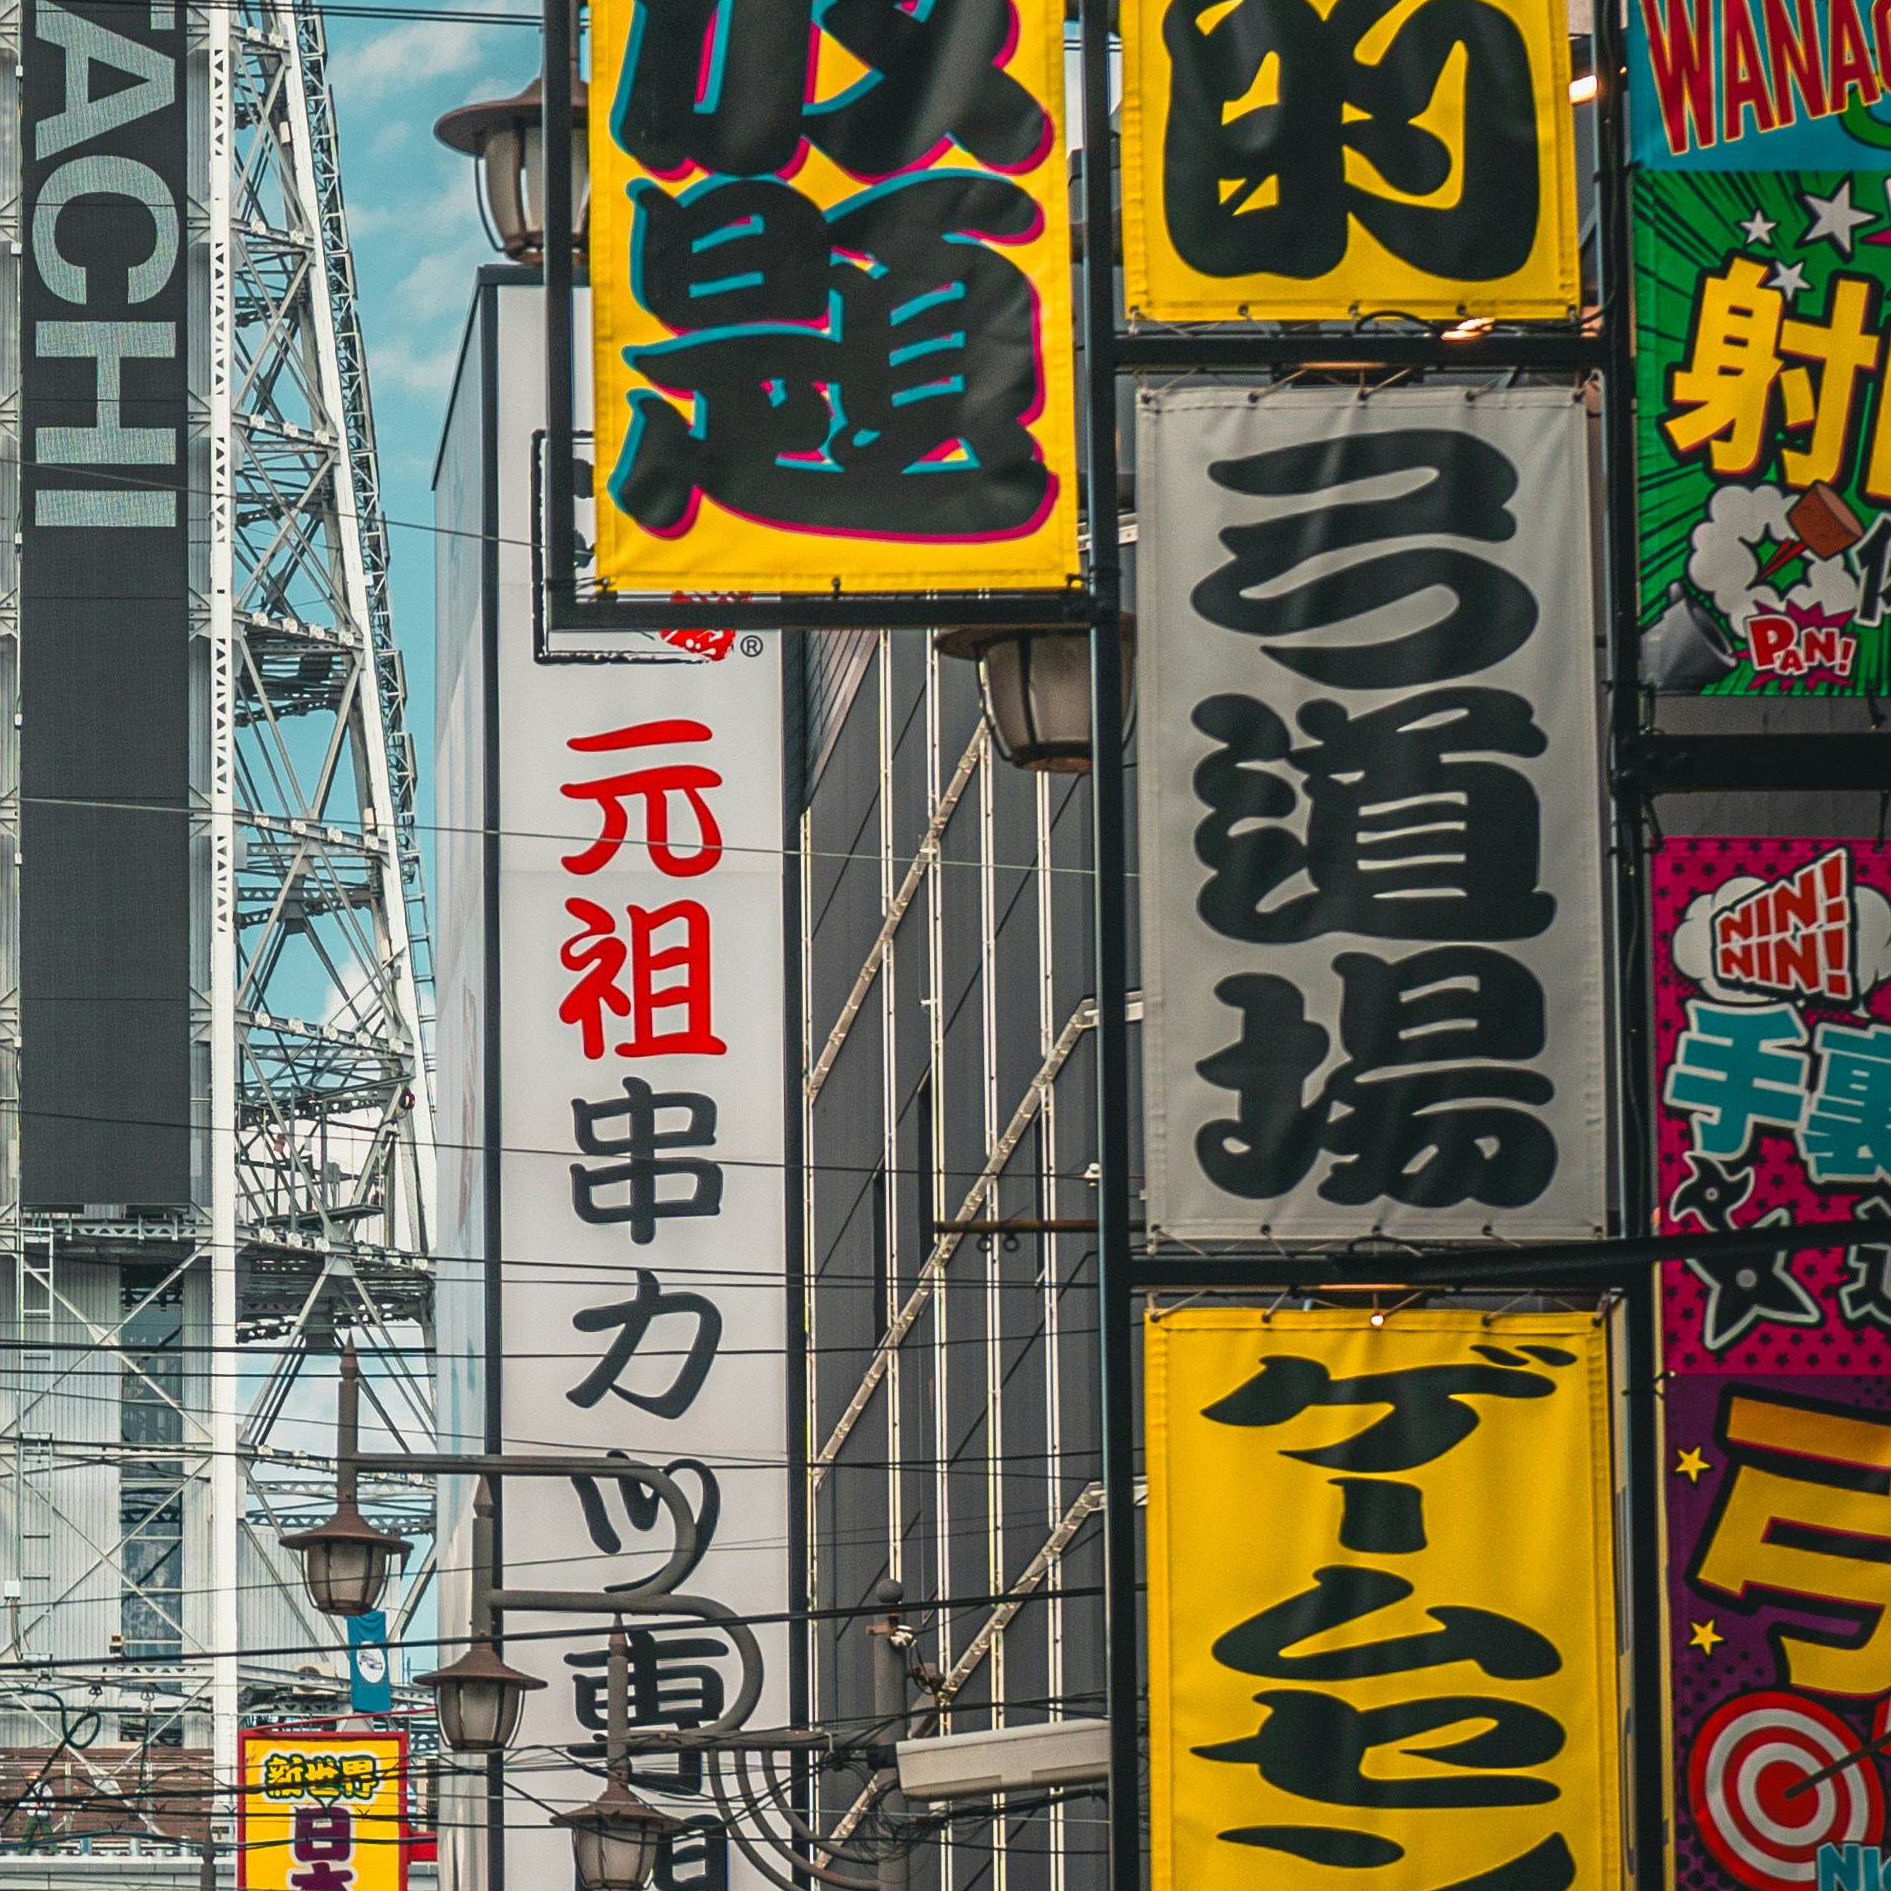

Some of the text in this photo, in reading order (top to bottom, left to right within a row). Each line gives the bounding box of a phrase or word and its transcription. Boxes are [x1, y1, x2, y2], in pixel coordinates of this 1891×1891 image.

[1746, 615, 1856, 678] PAN!
[1190, 428, 1558, 1210] 弓道場
[265, 1753, 379, 1798] 新世界
